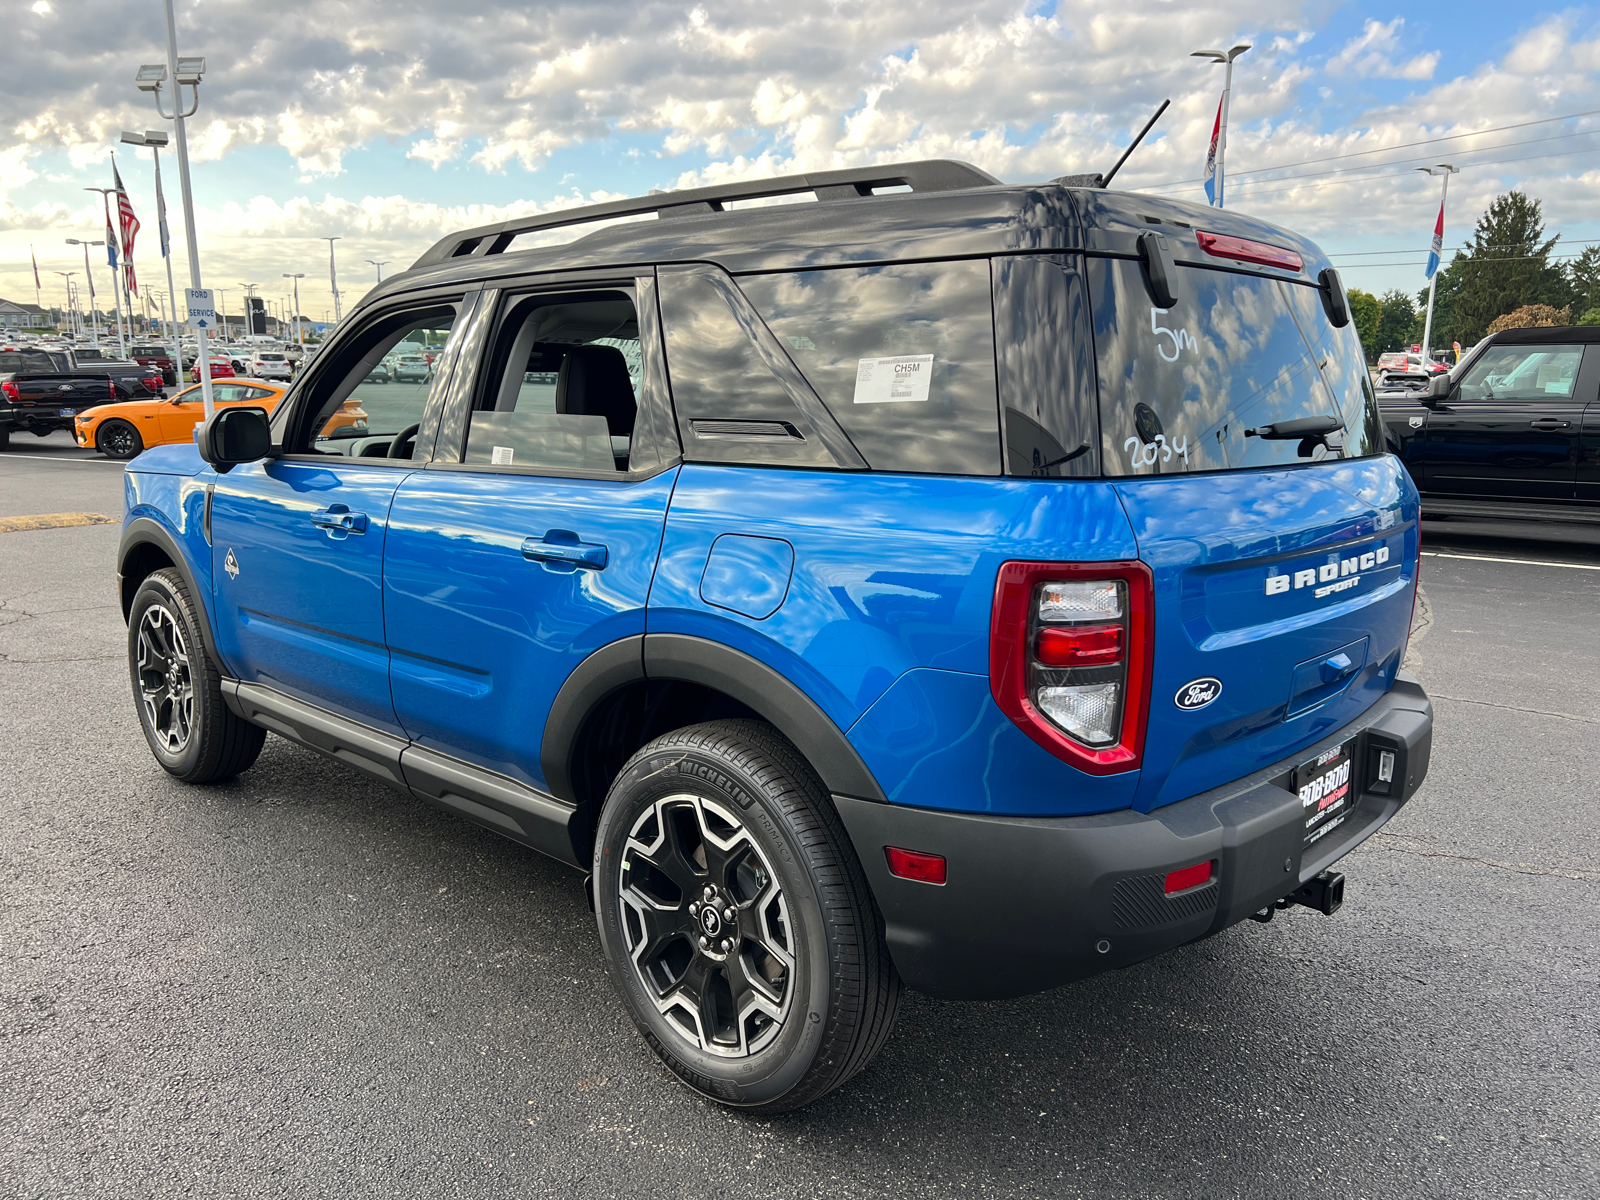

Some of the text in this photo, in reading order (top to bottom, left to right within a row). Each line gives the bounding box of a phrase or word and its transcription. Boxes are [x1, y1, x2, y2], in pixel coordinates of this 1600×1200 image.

[190, 290, 208, 299] FORD
[188, 308, 215, 317] SERVICE
[894, 363, 920, 373] CH5M
[1124, 434, 1189, 468] 2034
[1265, 546, 1390, 596] BRONCO
[1314, 576, 1361, 599] SPORT
[1184, 682, 1215, 706] Ford
[680, 761, 751, 807] MICHELIN
[758, 813, 793, 865] PRIMACY
